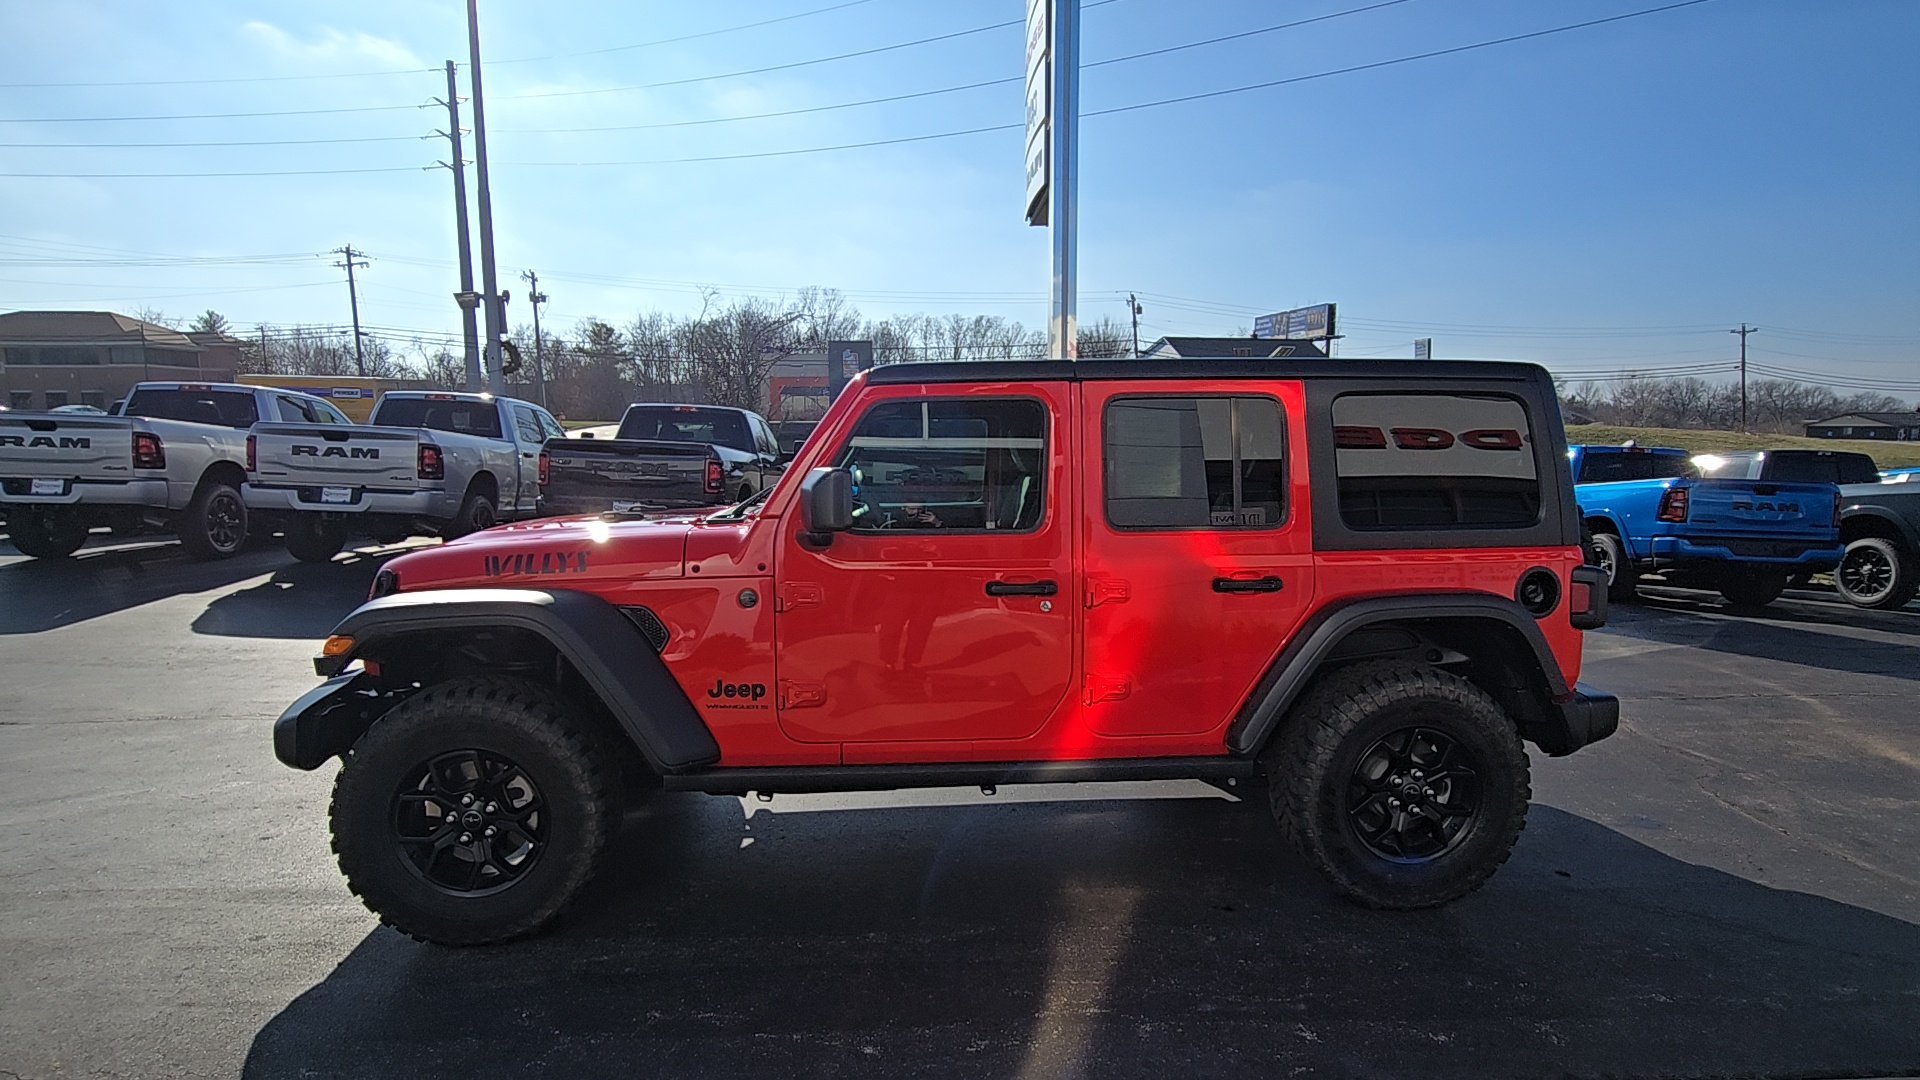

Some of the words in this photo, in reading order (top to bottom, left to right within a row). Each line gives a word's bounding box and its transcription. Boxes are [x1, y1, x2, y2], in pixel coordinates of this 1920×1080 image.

[0, 435, 91, 449] RAM
[291, 444, 381, 460] RAM
[584, 459, 669, 476] RAM
[1731, 501, 1800, 513] RAM
[484, 550, 592, 577] WILLYS
[707, 679, 766, 702] Jeep
